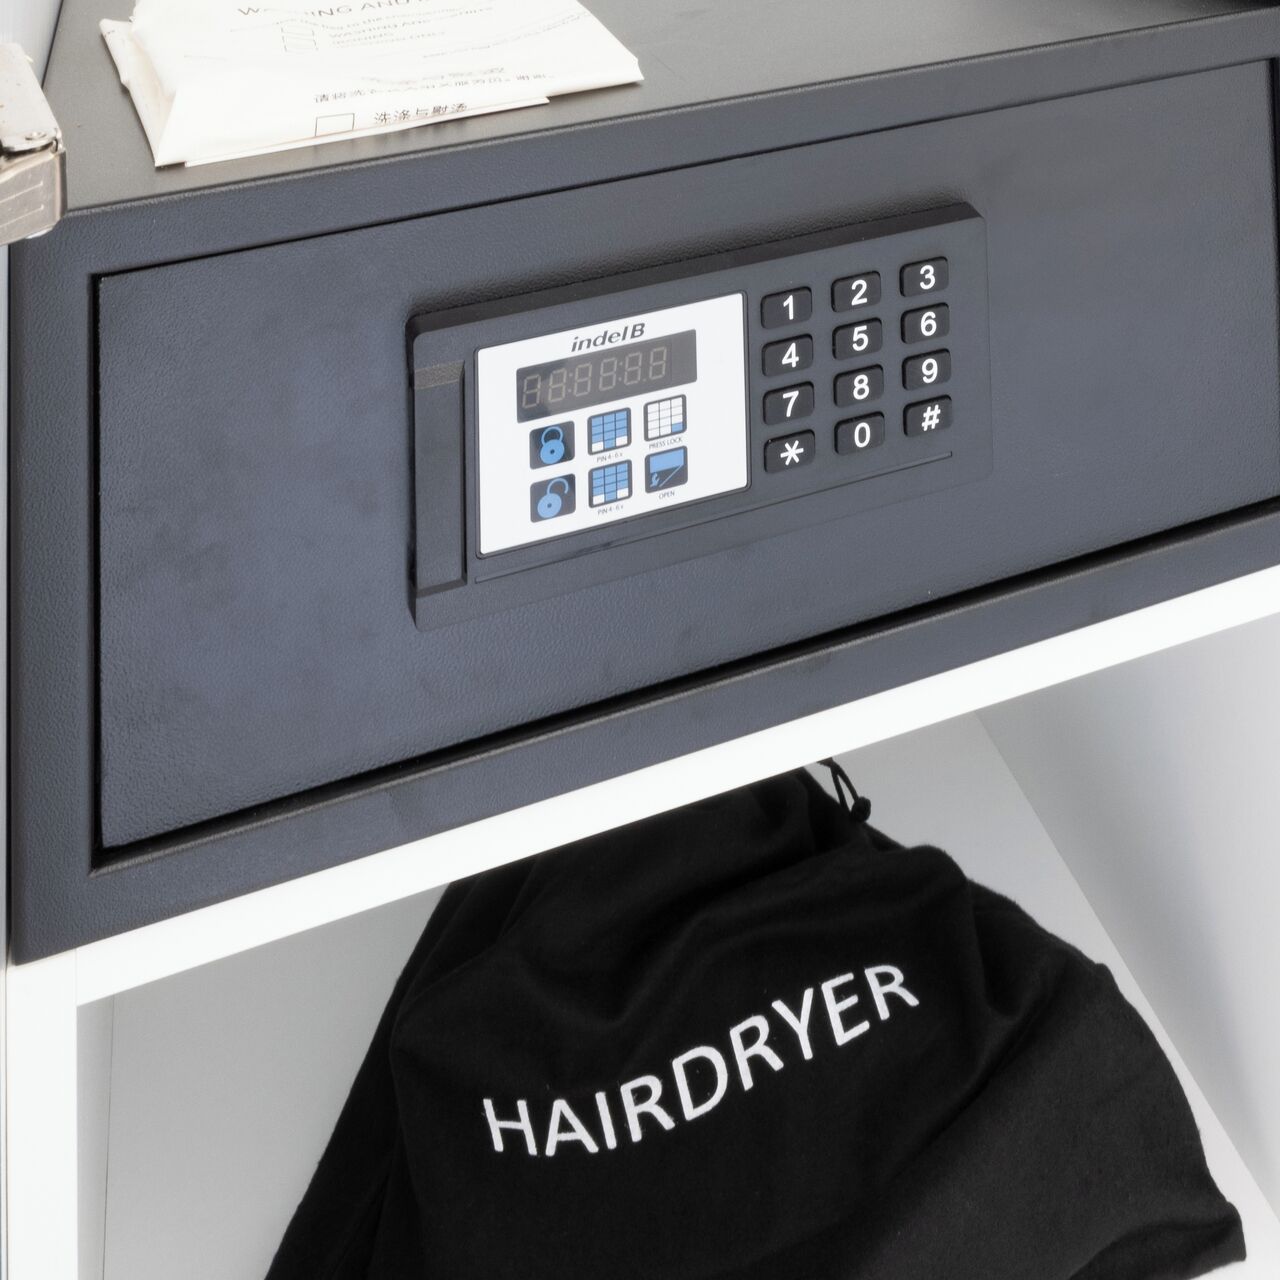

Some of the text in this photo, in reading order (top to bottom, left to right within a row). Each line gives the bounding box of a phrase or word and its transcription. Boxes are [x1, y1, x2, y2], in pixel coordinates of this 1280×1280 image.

[237, 4, 352, 17] WING
[782, 264, 936, 321] 1 2 3
[781, 311, 937, 368] 4 5 6
[782, 357, 939, 418] 7 8 9
[649, 437, 683, 449] PRESS LOCK
[853, 421, 871, 448] 0
[921, 404, 941, 432] #
[596, 454, 607, 462] PIN
[658, 491, 675, 500] OPEN
[483, 964, 919, 1157] HAIRDRYER
